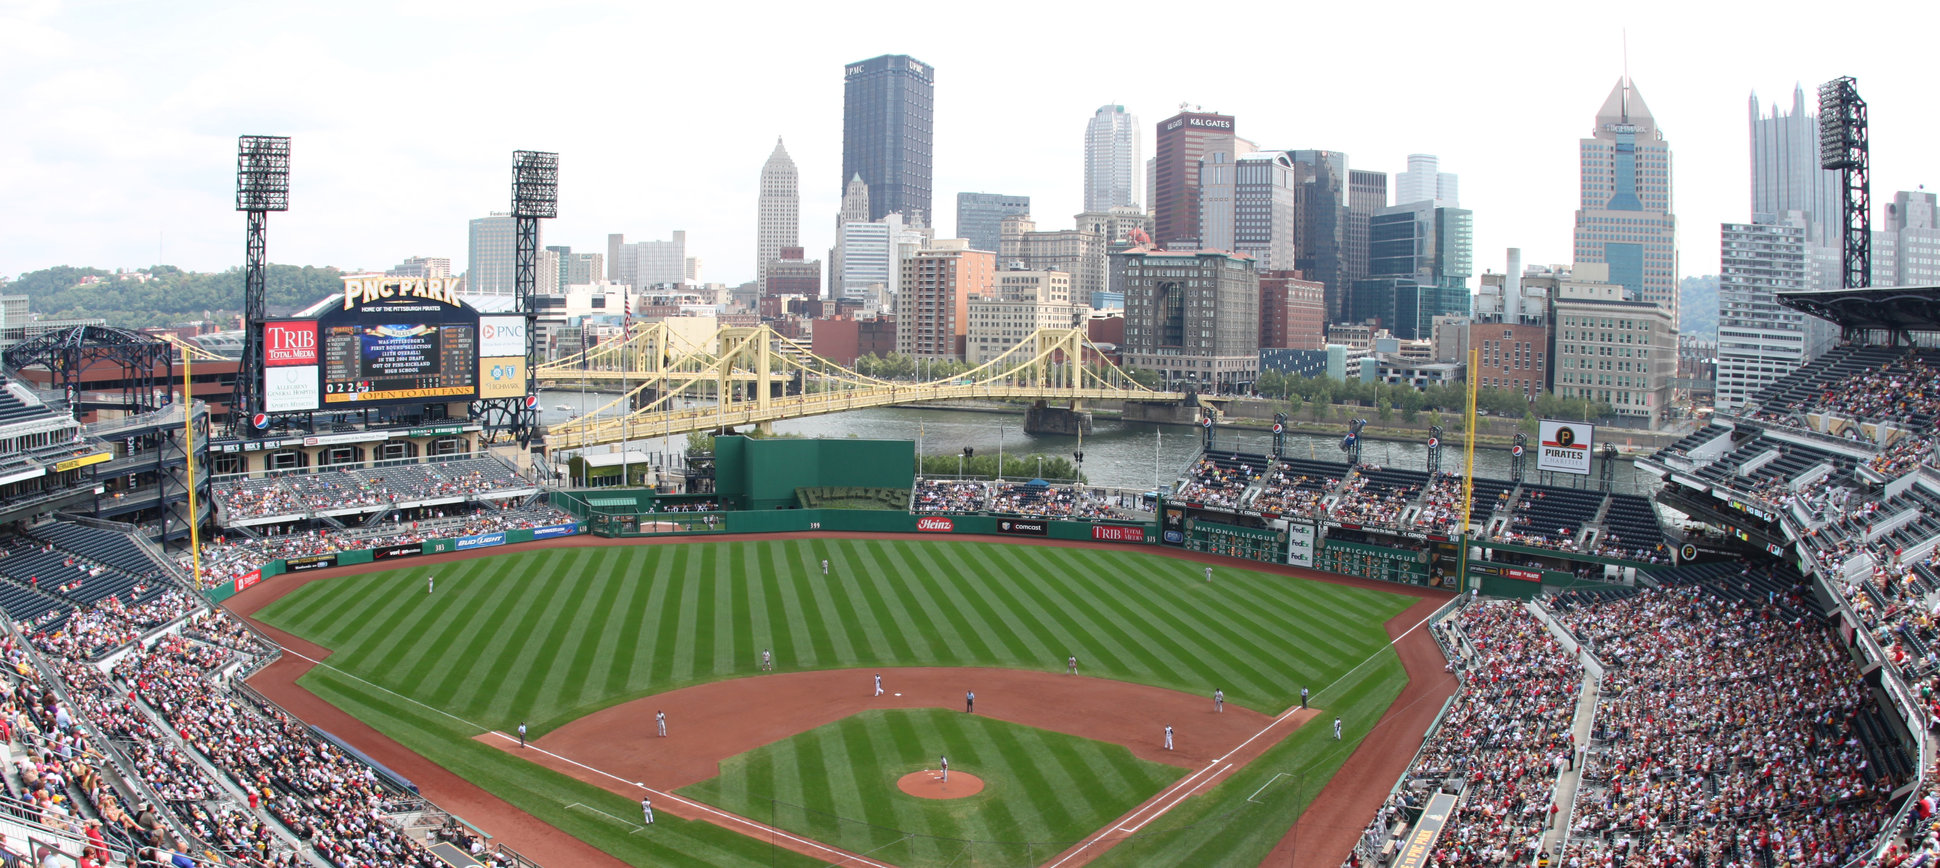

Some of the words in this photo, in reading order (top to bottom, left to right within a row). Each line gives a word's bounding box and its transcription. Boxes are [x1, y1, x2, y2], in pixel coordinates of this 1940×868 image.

[910, 60, 924, 74] UPMC
[1206, 120, 1230, 128] GATES
[344, 277, 394, 310] PNC
[398, 277, 461, 308] PARK
[497, 326, 522, 337] PNC
[268, 327, 315, 348] TRIB
[269, 349, 292, 358] TOTAL
[293, 349, 315, 357] MEDIA
[327, 384, 333, 393] 0
[337, 383, 344, 392] 2
[347, 383, 354, 391] 2
[1562, 432, 1570, 443] P
[1545, 449, 1583, 459] PIRATES
[918, 519, 952, 530] Heinz
[1092, 525, 1121, 539] TRIB
[1195, 526, 1238, 536] NATIONAL
[1242, 532, 1275, 541] LEAGUE
[458, 538, 475, 546] BUD
[479, 536, 503, 544] LIGHT
[1326, 545, 1375, 556] AMERICAN
[1379, 550, 1416, 562] LEAGUE
